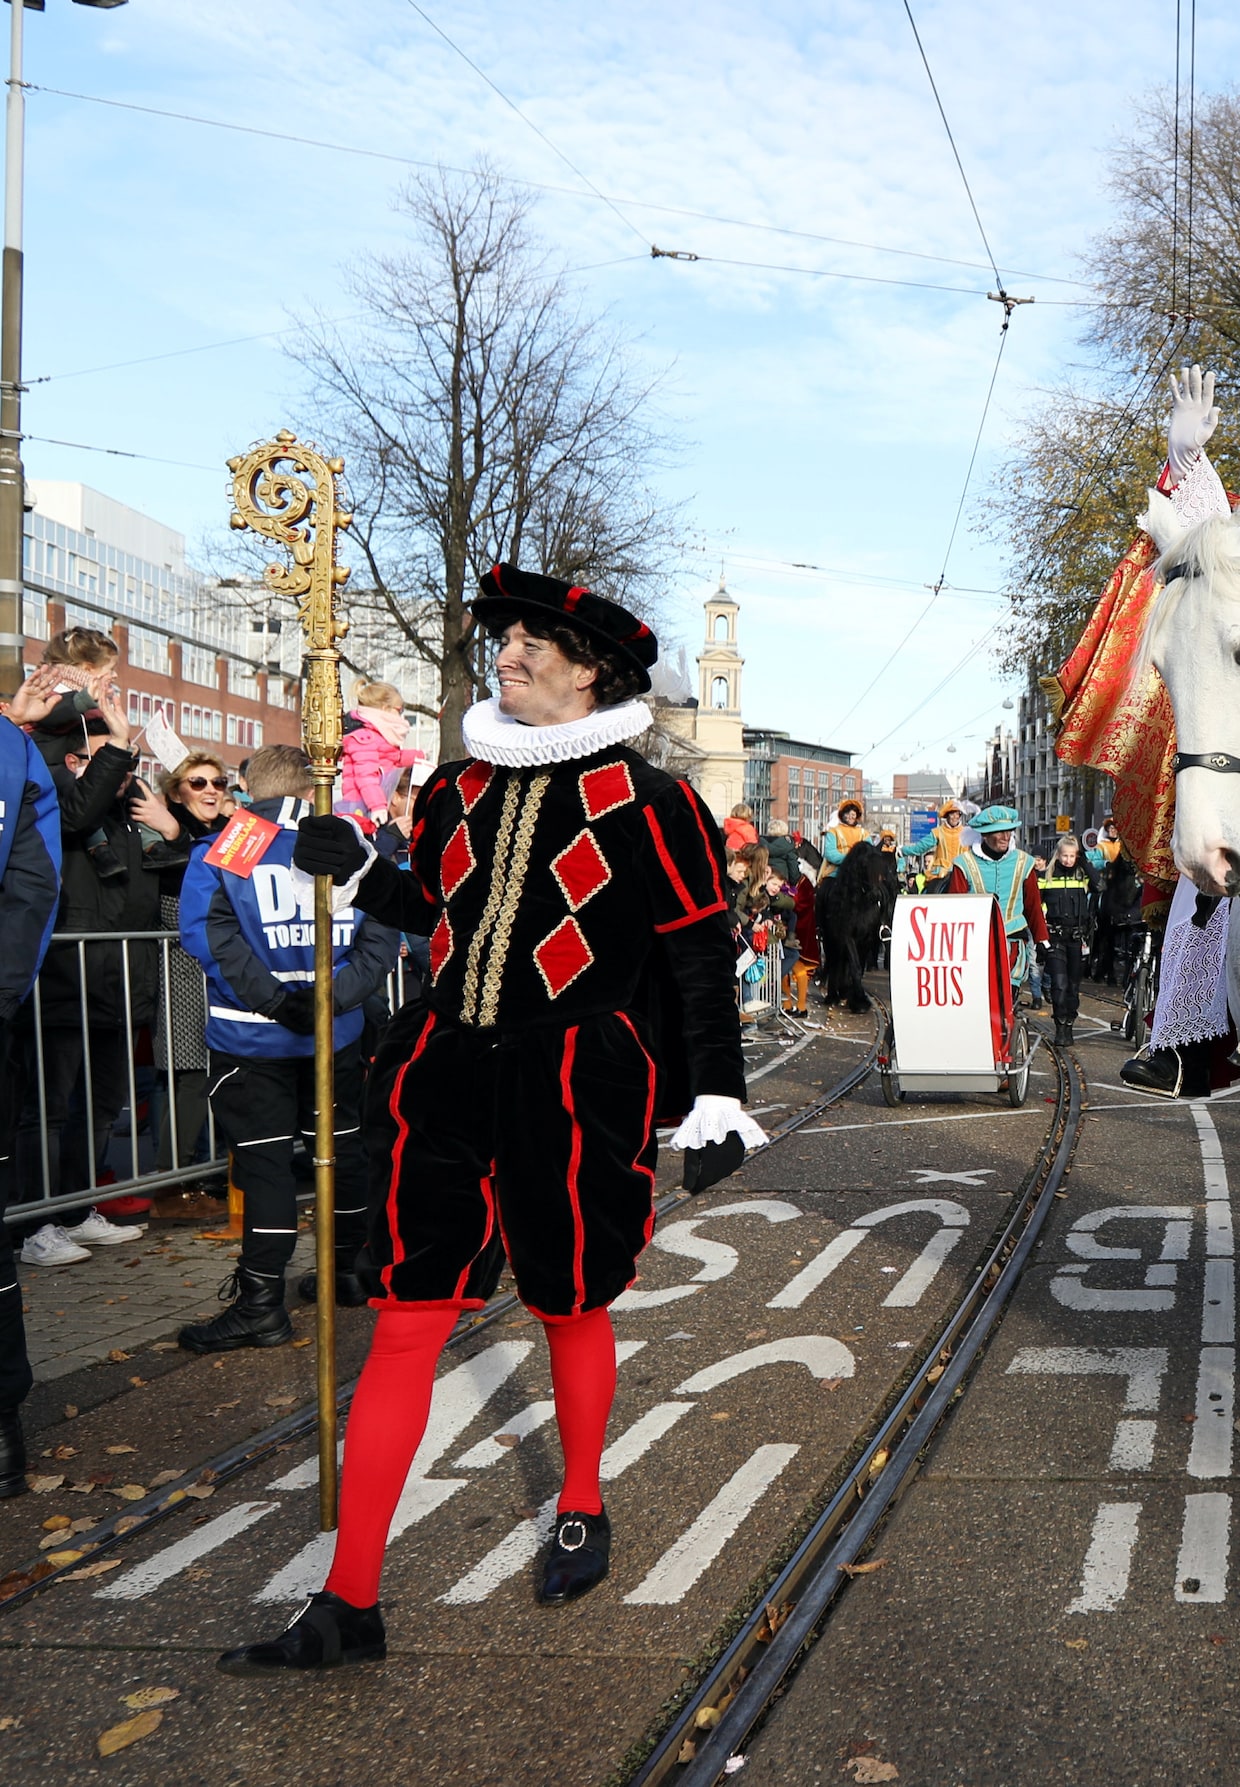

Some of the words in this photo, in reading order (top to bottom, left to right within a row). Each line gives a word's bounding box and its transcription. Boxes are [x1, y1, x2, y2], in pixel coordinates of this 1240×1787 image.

[217, 822, 245, 855] WELKOM
[220, 817, 257, 866] SINTERKLAAS
[907, 906, 975, 962] SINT
[916, 966, 964, 1007] BUS
